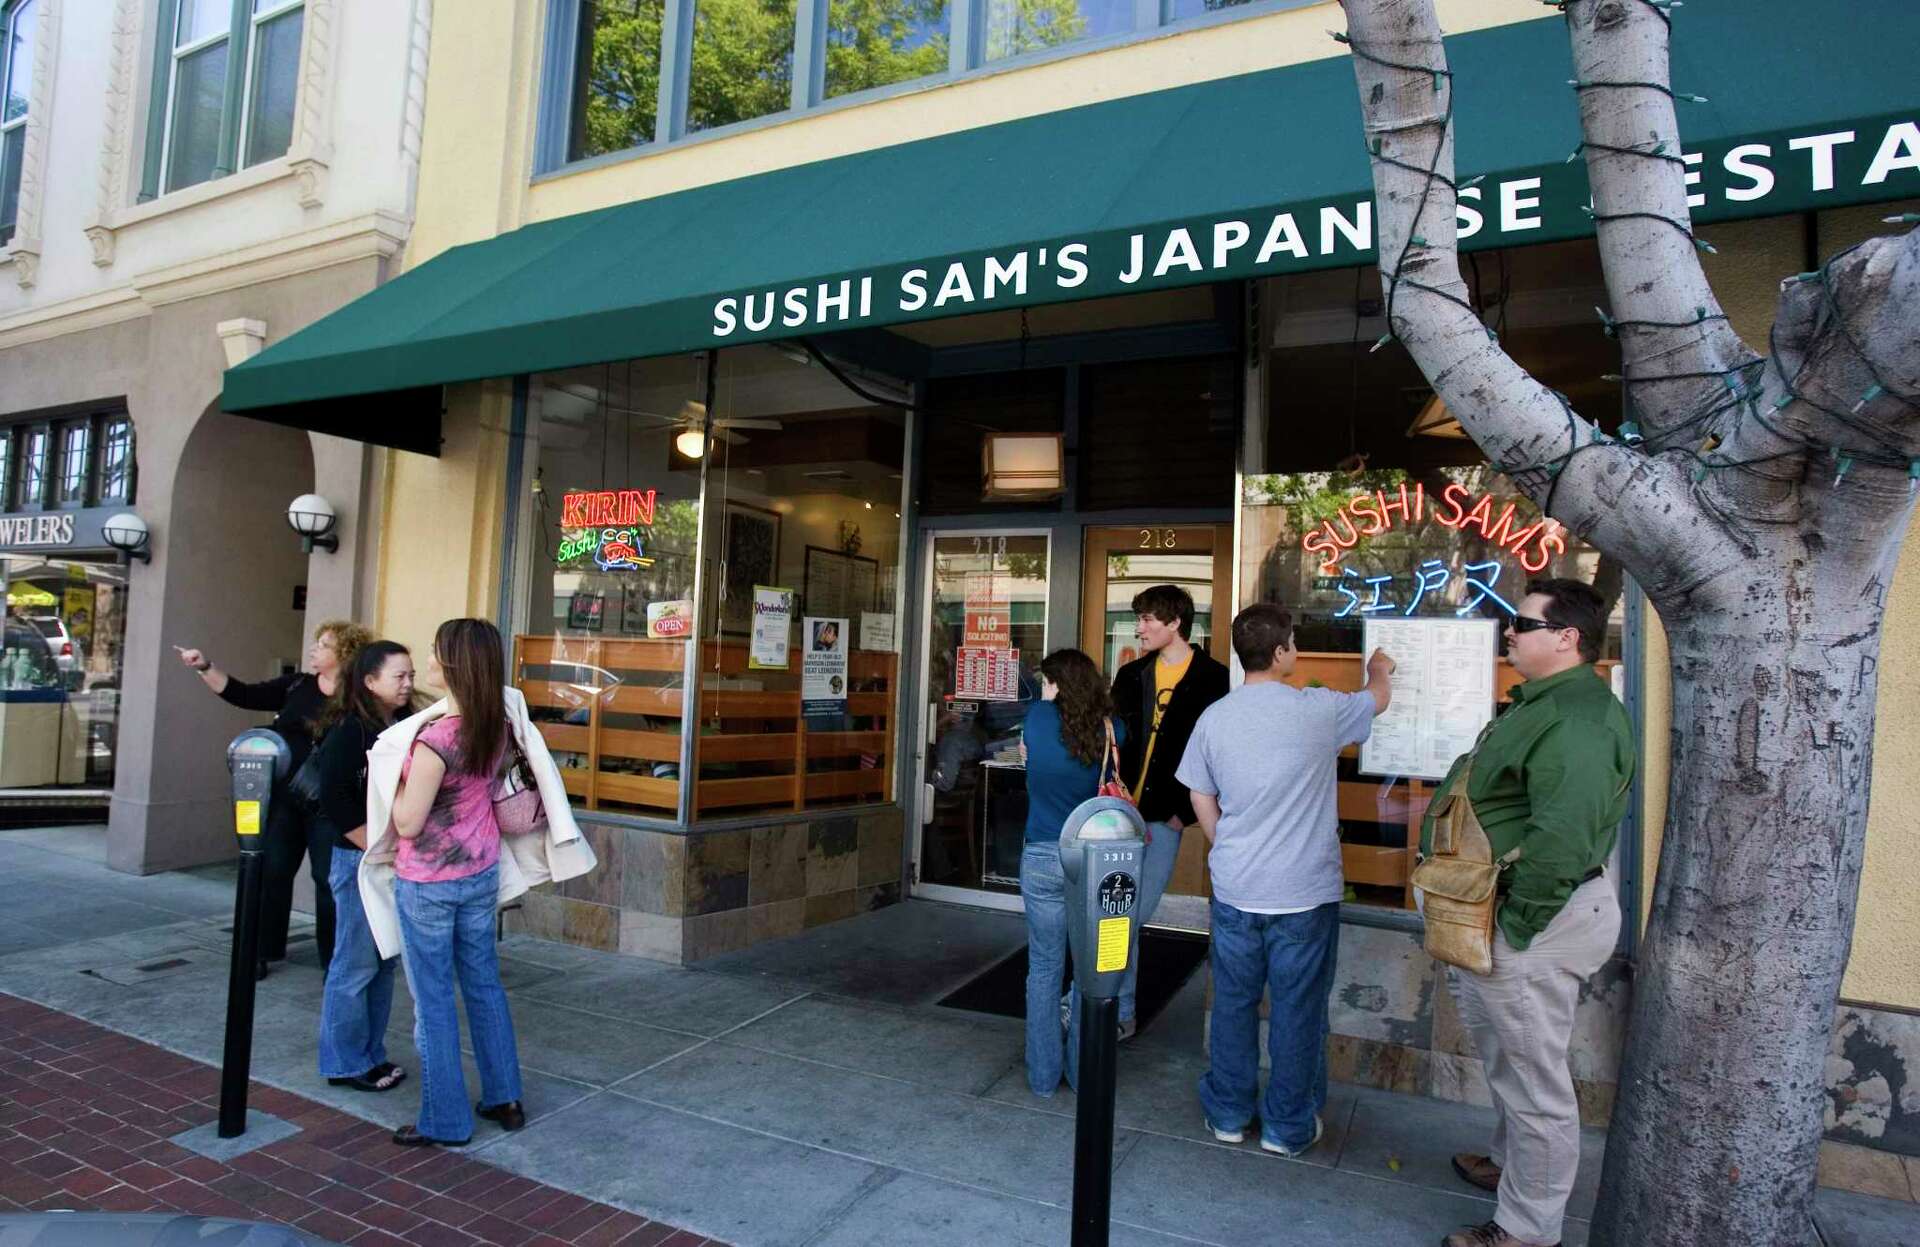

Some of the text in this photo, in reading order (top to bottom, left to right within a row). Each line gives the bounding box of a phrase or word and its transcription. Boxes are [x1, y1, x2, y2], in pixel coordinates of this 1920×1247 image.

[711, 121, 1920, 338] SUSHI SAM'S JAPANSE STA
[561, 489, 657, 527] KIRIN
[1302, 481, 1566, 572] SUSHI SAM'S
[557, 528, 599, 562] Sushi
[1138, 528, 1177, 549] 218
[972, 535, 1007, 564] 218
[655, 618, 684, 632] OPEN
[976, 615, 998, 632] NO
[966, 631, 1009, 642] SOLICITING
[1114, 874, 1122, 887] 2
[1102, 893, 1133, 914] HOUR
